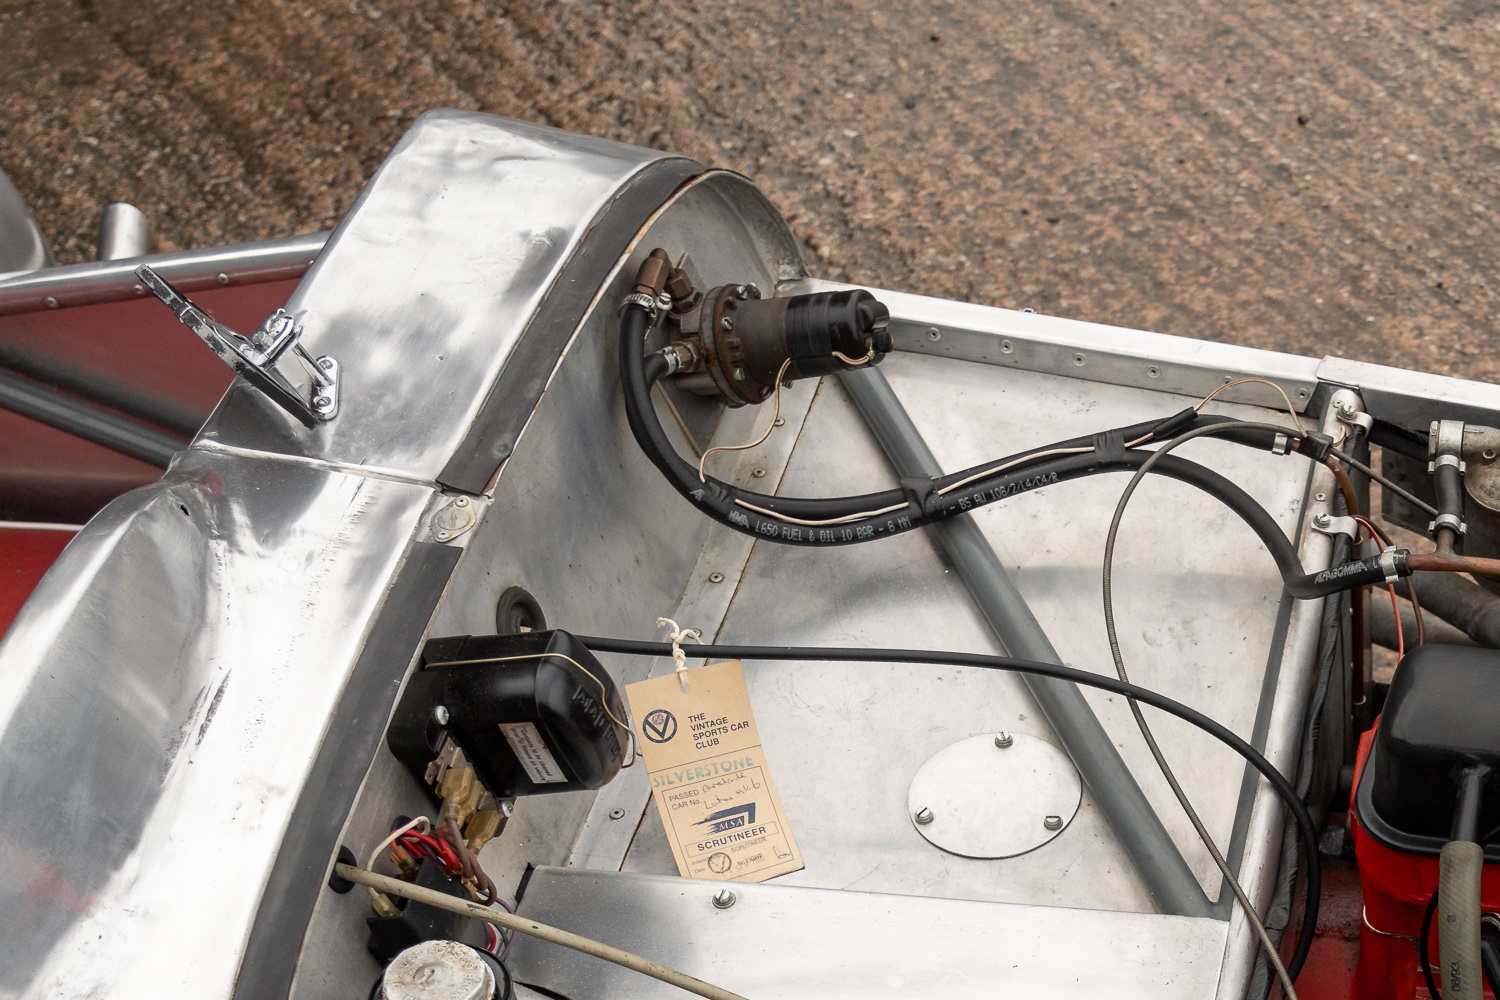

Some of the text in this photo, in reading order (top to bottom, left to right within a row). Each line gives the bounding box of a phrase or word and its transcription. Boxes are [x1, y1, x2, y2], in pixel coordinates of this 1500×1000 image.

[958, 496, 972, 510] BS
[974, 492, 987, 505] AU
[782, 528, 803, 541] FUEL
[809, 529, 816, 541] &
[820, 528, 836, 542] OIL
[842, 529, 853, 542] 10
[857, 525, 874, 539] BAR
[888, 521, 896, 532] 8
[899, 516, 912, 529] MM
[688, 712, 706, 723] THE
[690, 716, 729, 732] VINTAGE
[692, 721, 750, 741] SPORTS CAR
[695, 738, 720, 750] CLUB
[652, 756, 755, 788] SILVERSTONE
[669, 789, 700, 802] PASSED
[672, 801, 689, 811] CAR
[719, 816, 744, 832] MSA
[697, 826, 767, 851] SCRUTINEER
[731, 837, 767, 853] SCRUTINEER
